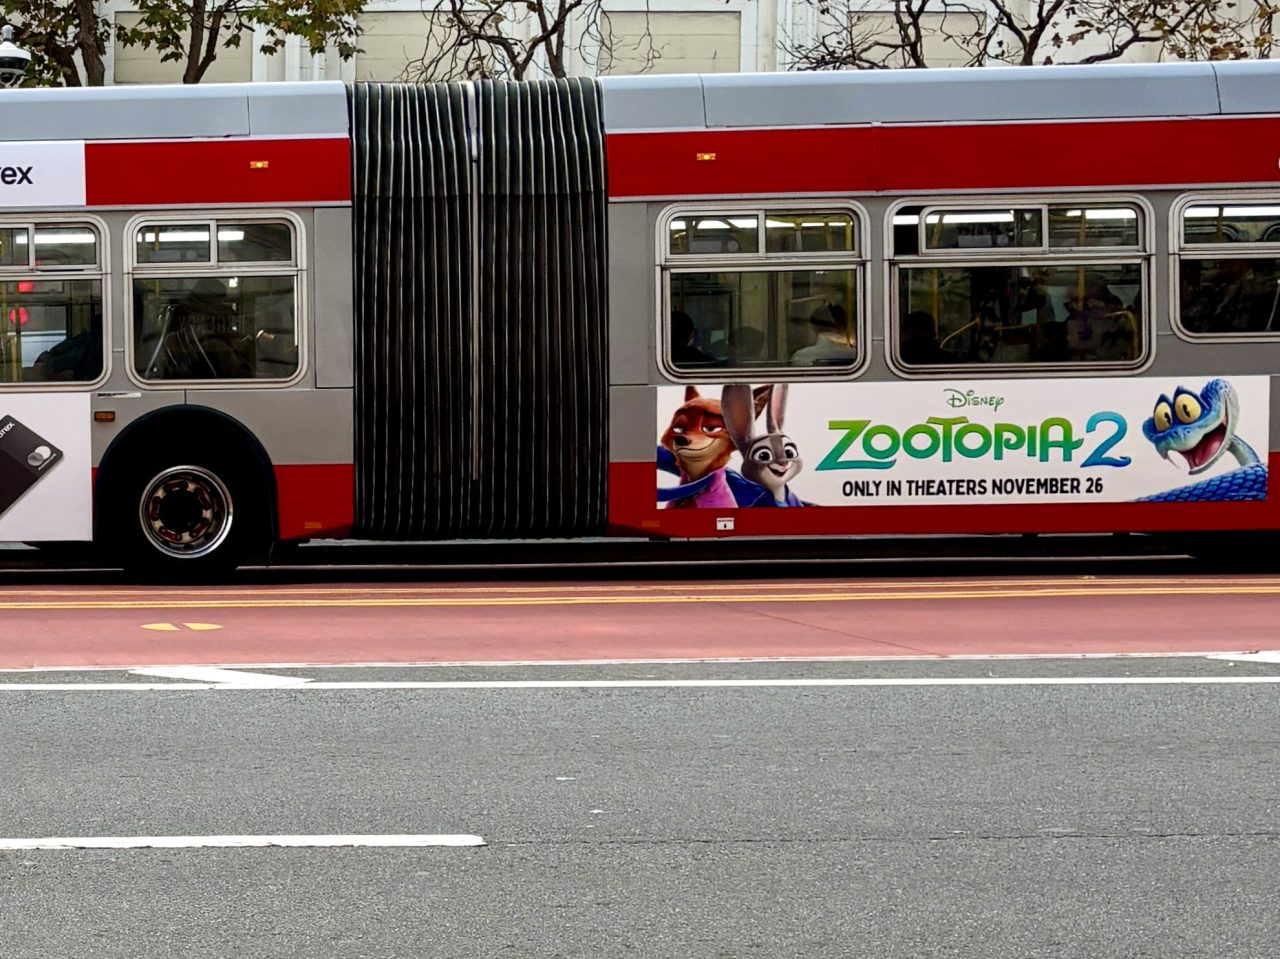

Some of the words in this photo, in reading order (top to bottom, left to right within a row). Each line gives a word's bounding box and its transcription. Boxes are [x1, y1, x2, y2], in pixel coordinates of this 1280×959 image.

[943, 388, 1005, 412] Disney
[815, 415, 1084, 472] ZOOTOPIA
[1080, 410, 1132, 468] 2
[842, 480, 883, 497] ONLY
[886, 480, 902, 496] IN
[906, 478, 988, 496] THEATERS
[992, 477, 1081, 495] NOVEMBER
[1086, 476, 1104, 494] 26
